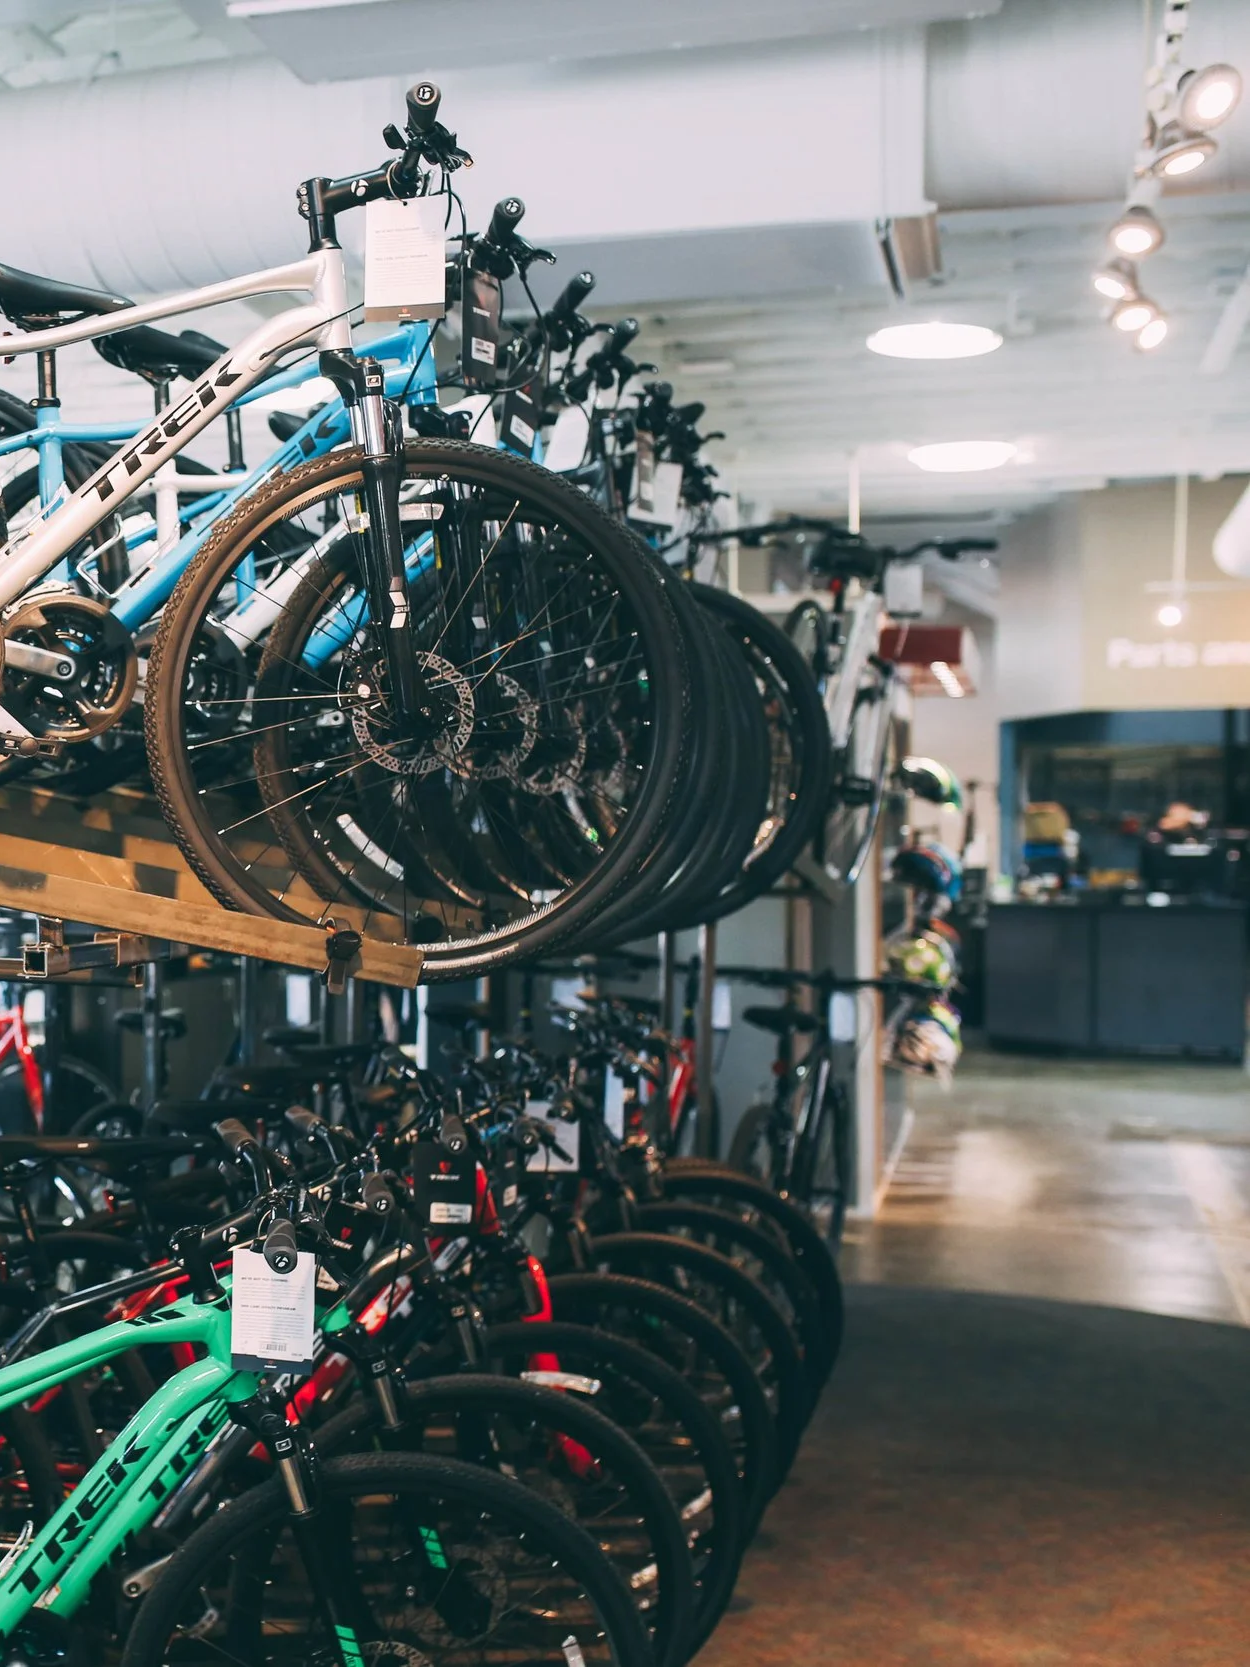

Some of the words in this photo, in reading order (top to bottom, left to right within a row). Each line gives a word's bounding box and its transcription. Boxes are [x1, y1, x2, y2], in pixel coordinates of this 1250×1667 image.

[81, 358, 242, 501] TREK
[8, 1430, 150, 1594] TREK
[138, 1398, 231, 1502] TRE
